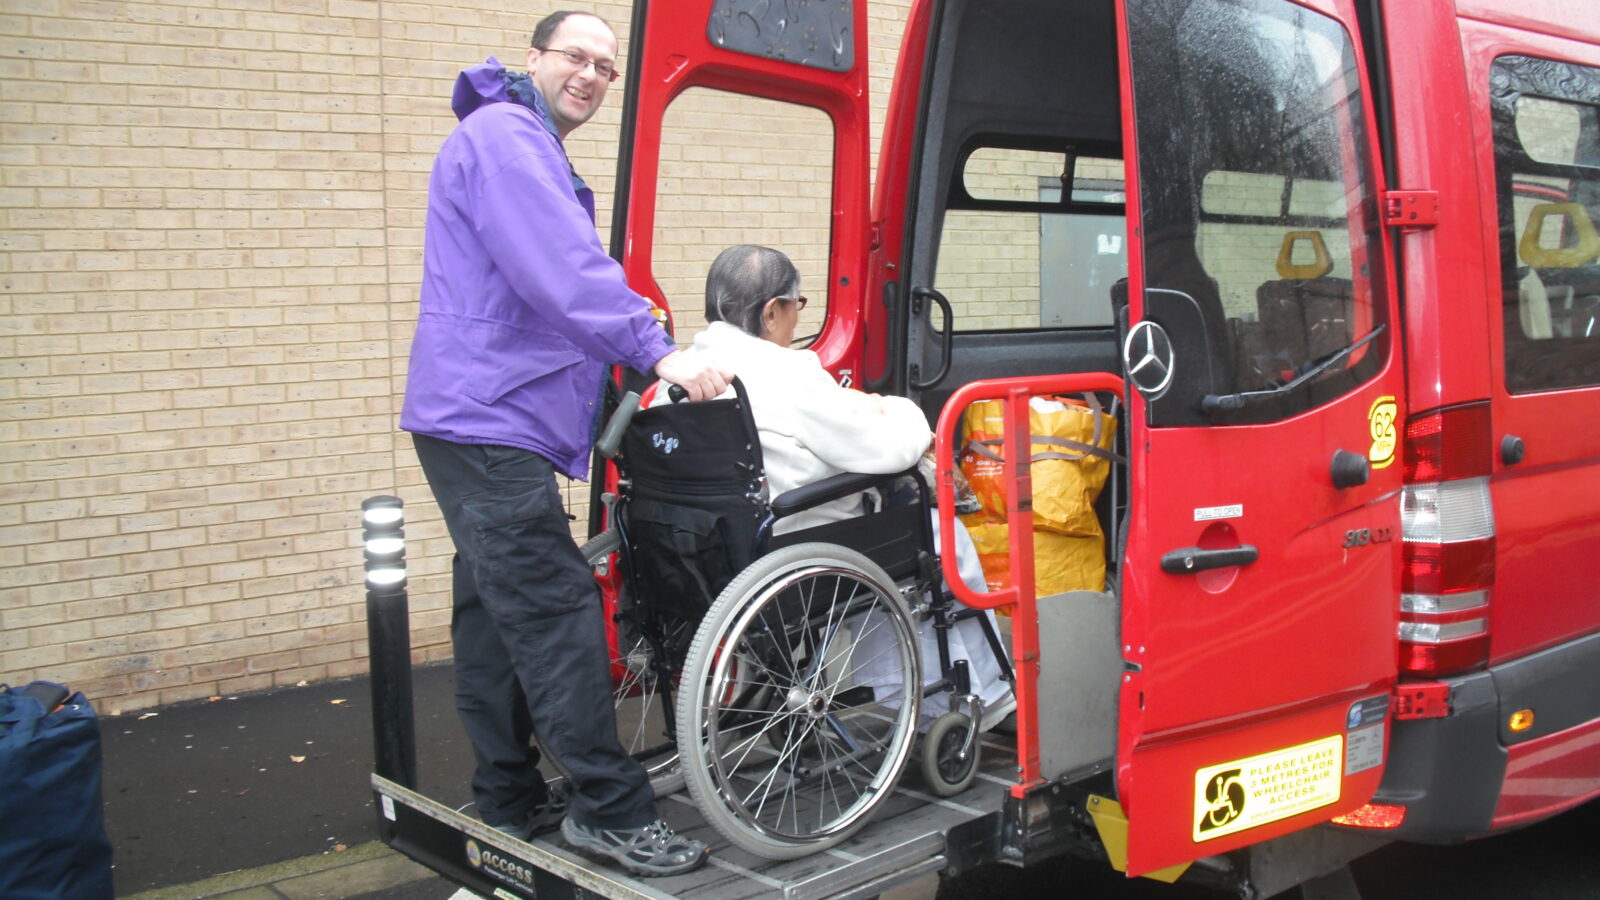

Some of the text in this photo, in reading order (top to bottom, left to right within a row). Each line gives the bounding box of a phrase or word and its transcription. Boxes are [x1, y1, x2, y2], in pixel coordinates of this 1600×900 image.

[1375, 412, 1392, 438] 62
[1196, 509, 1212, 518] PULL
[1223, 506, 1241, 515] OPEN
[1250, 758, 1297, 777] PLEASE
[1300, 748, 1334, 764] LEAVE
[1250, 759, 1333, 789] 3 METRES FOR
[1253, 770, 1331, 798] WHEELCHAIR
[1269, 785, 1316, 804] ACCESS
[482, 850, 532, 884] access
